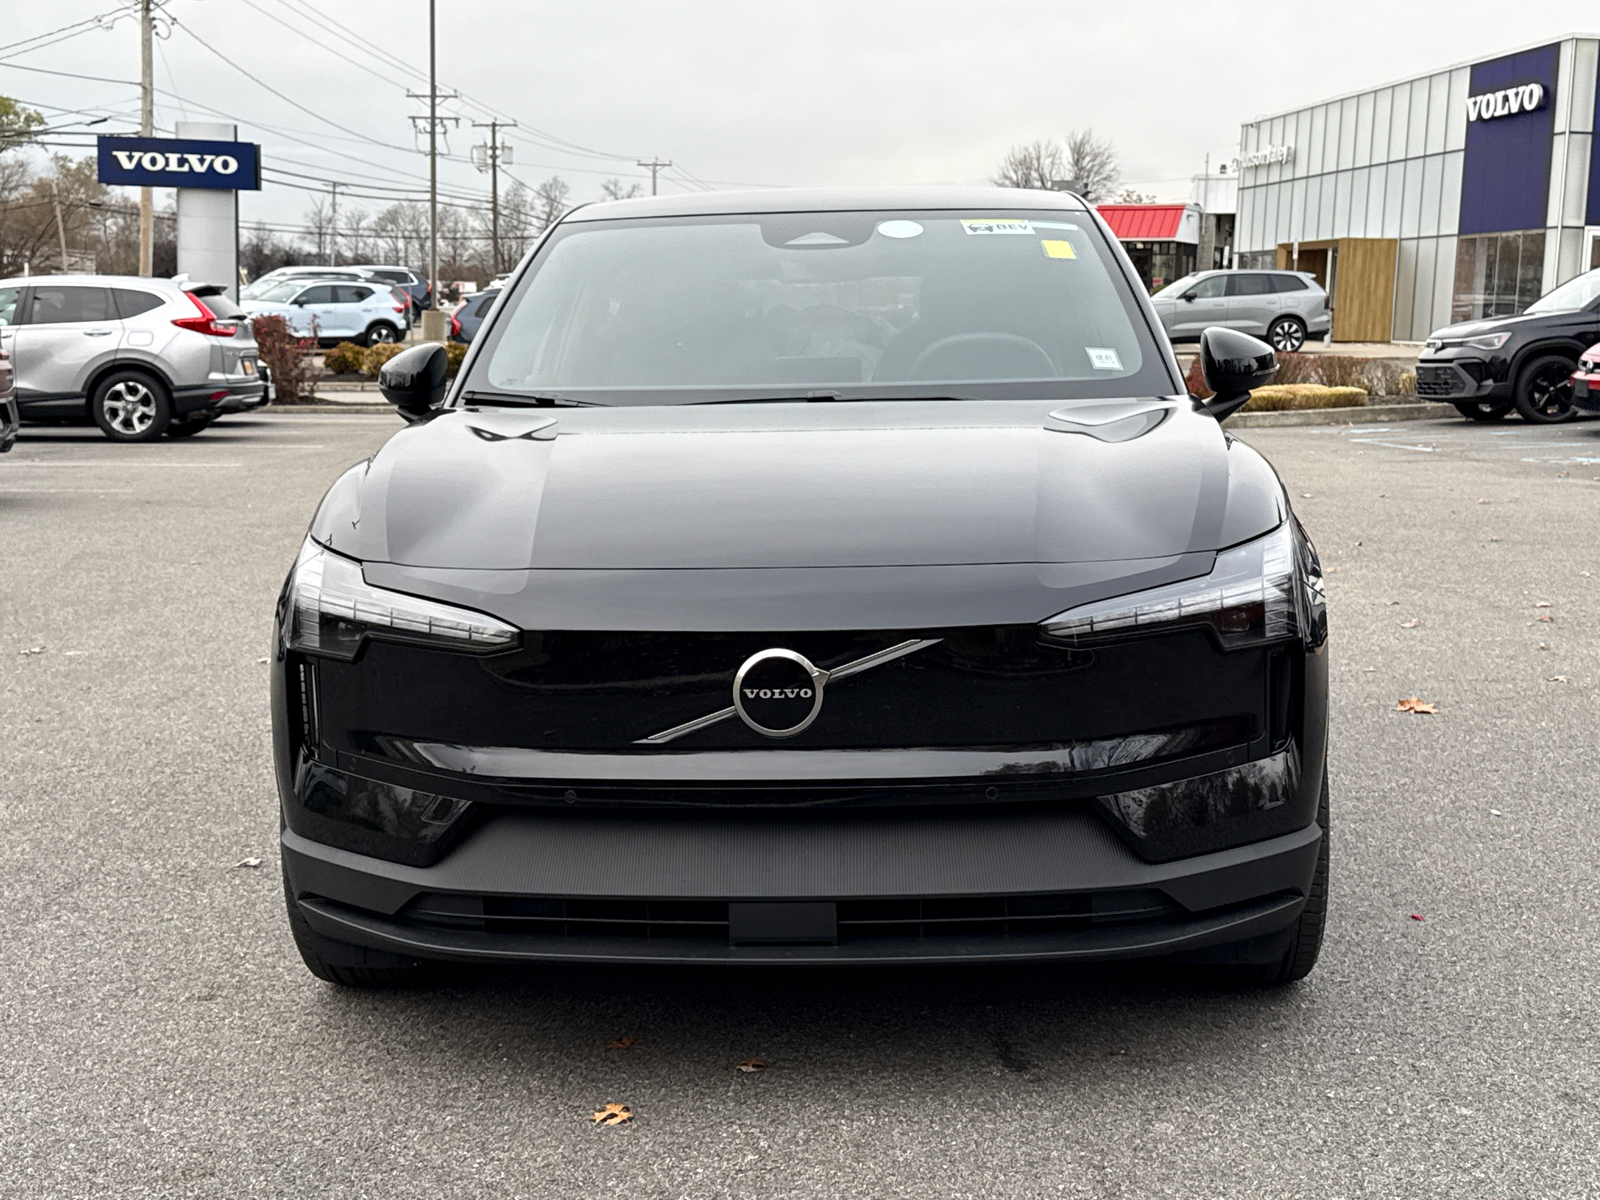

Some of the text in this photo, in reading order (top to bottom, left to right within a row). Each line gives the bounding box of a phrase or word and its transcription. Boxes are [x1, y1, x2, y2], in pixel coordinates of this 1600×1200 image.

[1466, 83, 1544, 122] VOLVO
[112, 150, 239, 175] VOLVO
[995, 223, 1028, 231] BEV
[742, 688, 813, 699] VOLVO
